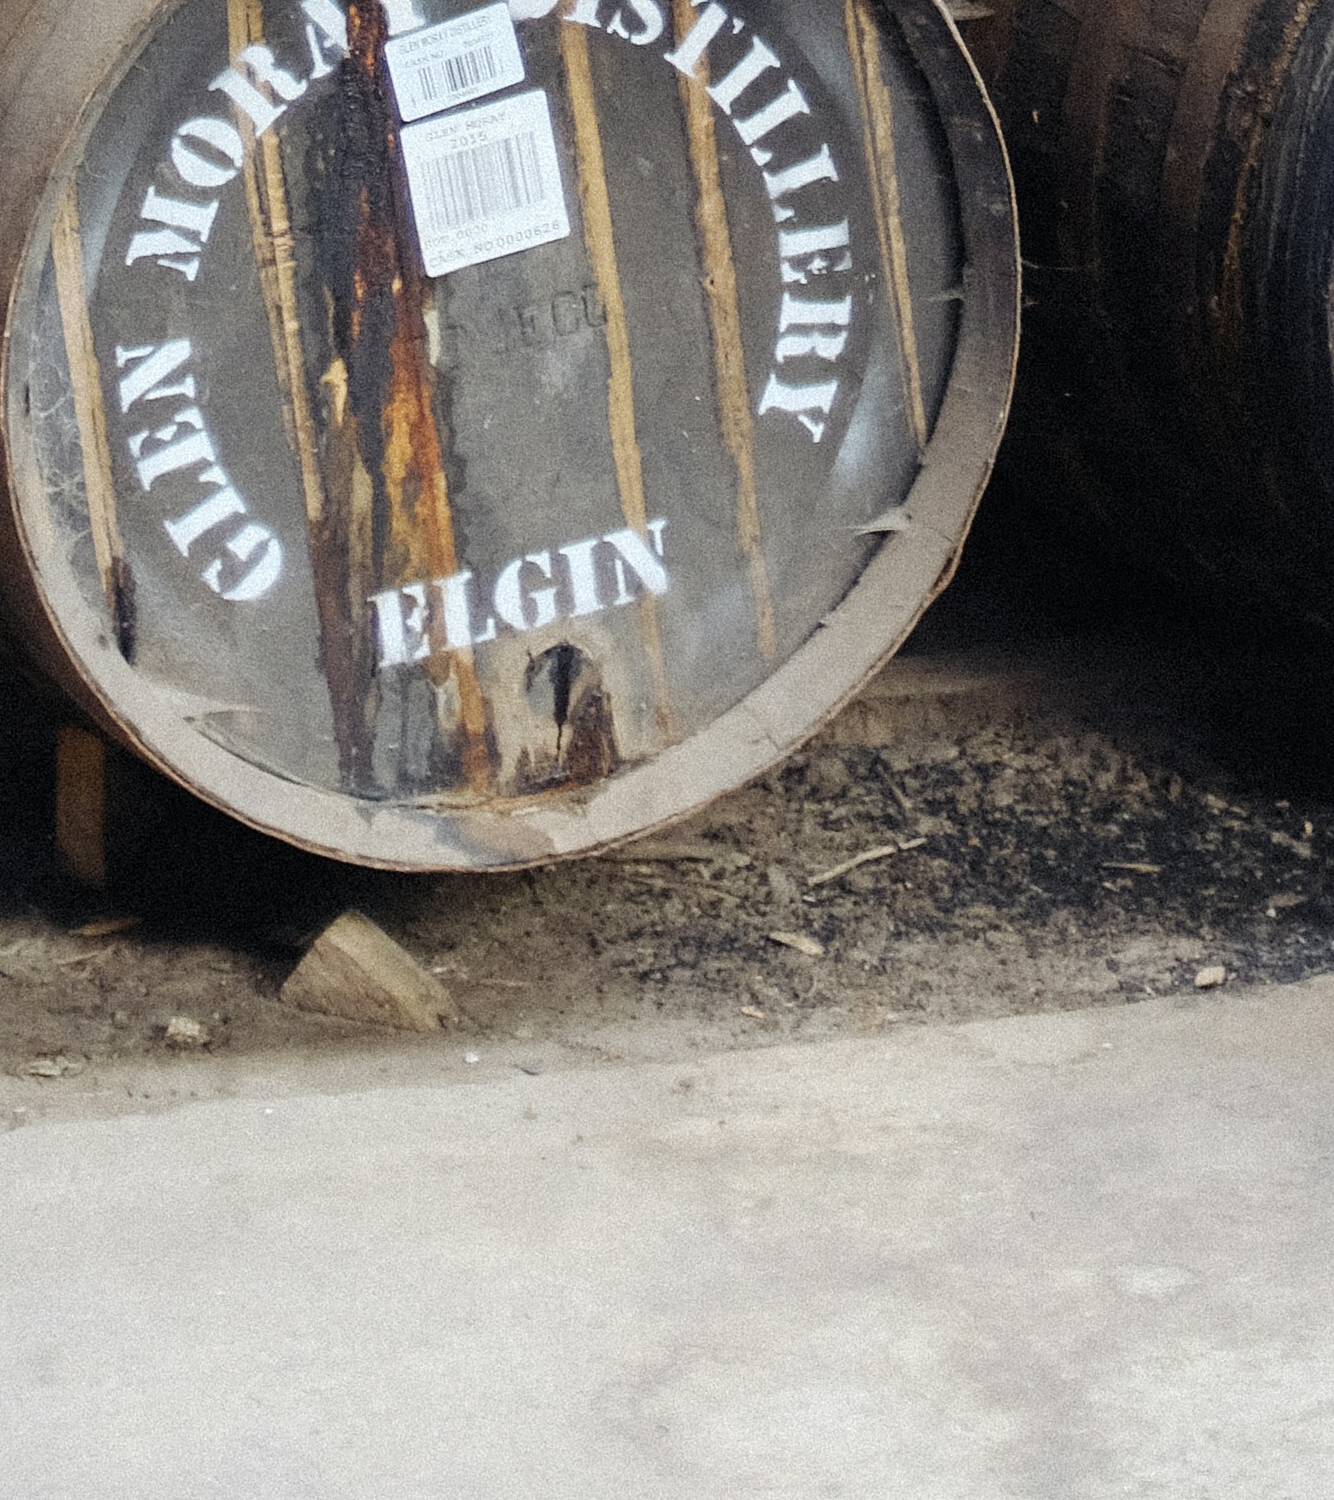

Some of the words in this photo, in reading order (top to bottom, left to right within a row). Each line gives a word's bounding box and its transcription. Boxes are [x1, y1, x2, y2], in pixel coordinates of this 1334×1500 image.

[451, 131, 488, 150] 2015
[116, 337, 284, 603] GLEN
[369, 520, 669, 668] ELGIN
